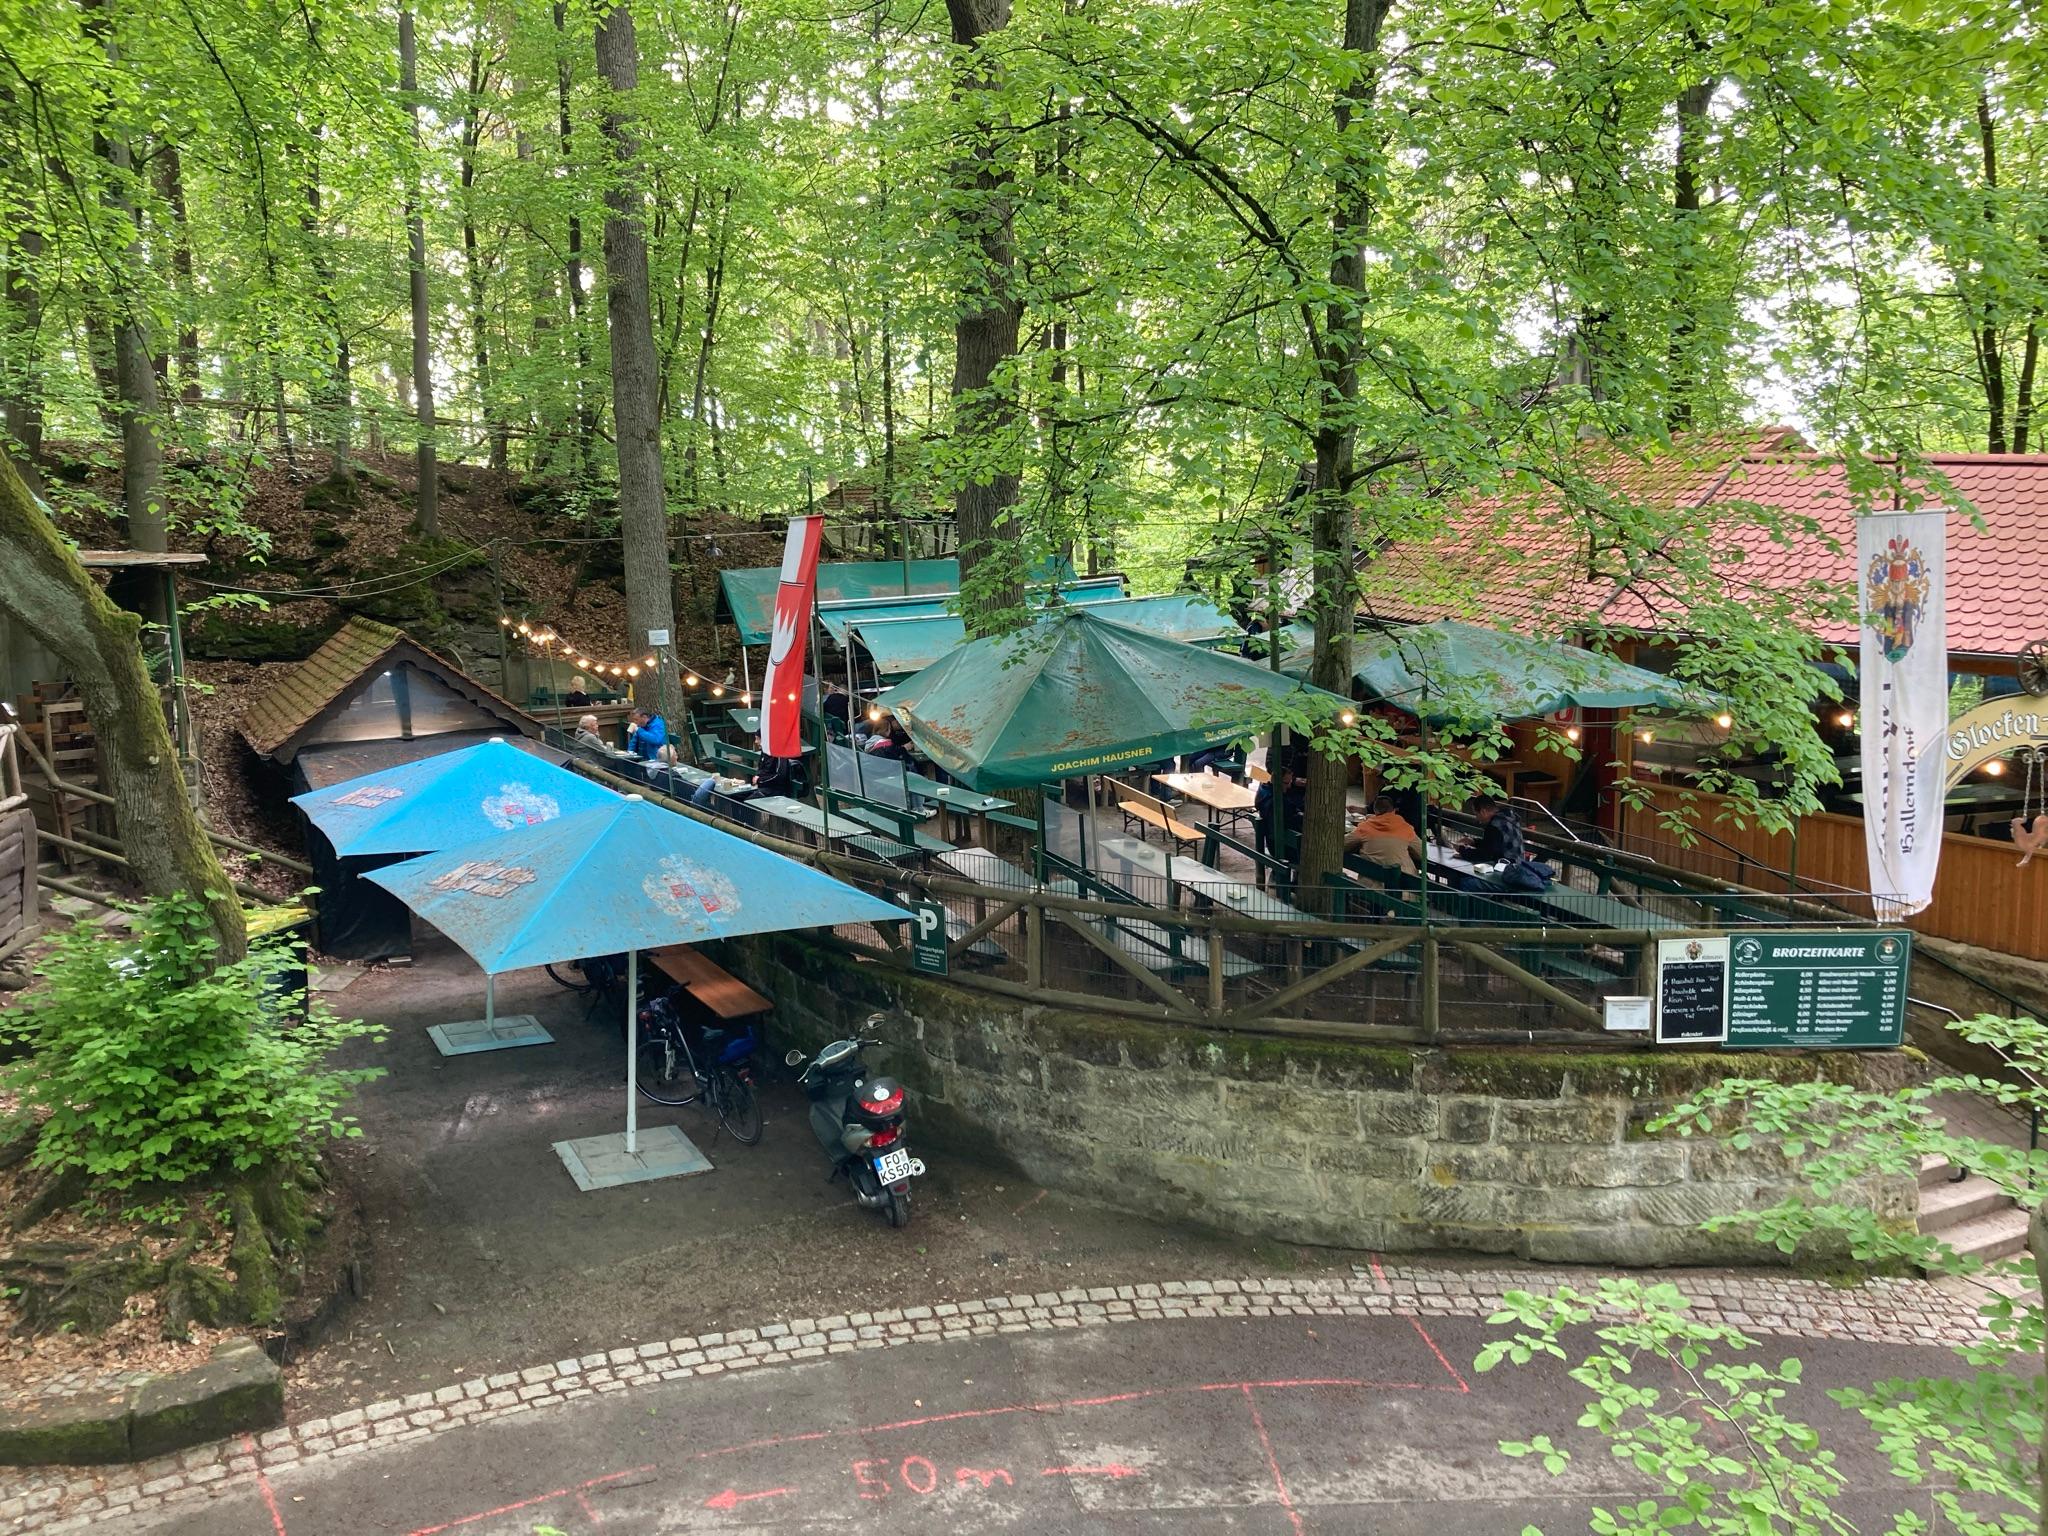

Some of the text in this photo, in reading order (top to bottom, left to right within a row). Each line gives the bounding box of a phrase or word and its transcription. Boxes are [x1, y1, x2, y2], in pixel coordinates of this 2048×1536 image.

[1051, 747, 1153, 773] JOACHIM HAUSNER
[1899, 726, 1916, 855] Hallerndorf
[919, 908, 938, 940] P
[1772, 947, 1866, 958] BROTZEITKARTE
[885, 1153, 900, 1169] FO
[852, 1455, 1015, 1499] 50 m
